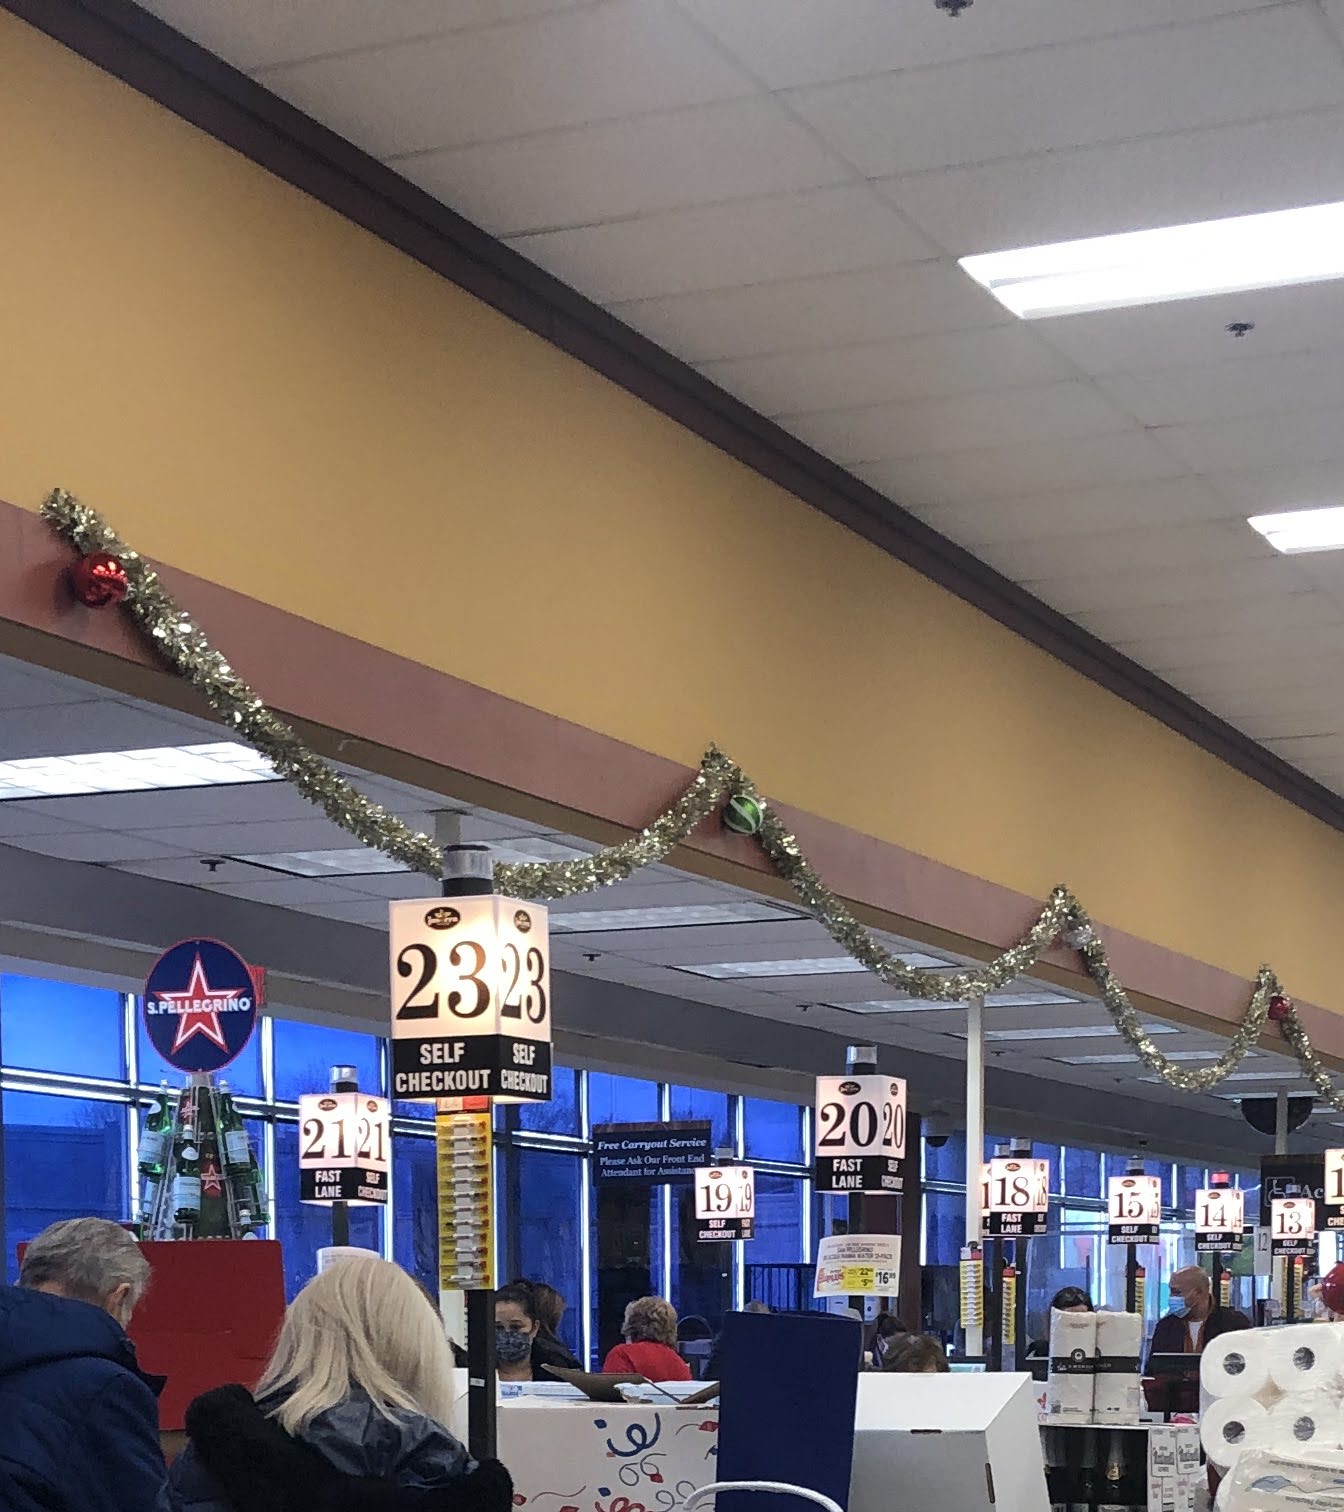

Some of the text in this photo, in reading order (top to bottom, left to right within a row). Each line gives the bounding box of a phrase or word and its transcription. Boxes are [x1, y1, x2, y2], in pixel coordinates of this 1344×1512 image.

[396, 941, 490, 1019] 23
[501, 943, 546, 1024] 23
[146, 995, 251, 1015] S.PELLEGRINO
[420, 1042, 465, 1064] SELF
[513, 1043, 536, 1065] SELF
[396, 1069, 491, 1092] CHECKOUT
[501, 1069, 548, 1094] CHECKOUT
[818, 1101, 878, 1147] 20
[883, 1102, 904, 1149] 20
[301, 1118, 352, 1160] 21
[357, 1117, 387, 1162] 21
[597, 1137, 708, 1151] Free Carryout Service
[599, 1157, 626, 1166] Please
[627, 1156, 642, 1165] Ask
[662, 1155, 686, 1164] Front
[687, 1153, 706, 1163] End
[832, 1158, 864, 1172] FAST
[314, 1170, 342, 1183] FAST
[601, 1167, 642, 1177] Attendant
[831, 1174, 864, 1189] LANE
[314, 1185, 342, 1198] LANE
[700, 1184, 733, 1213] 19
[995, 1176, 1031, 1207] 18
[1113, 1192, 1144, 1219] 15
[1200, 1204, 1228, 1228] 14
[709, 1219, 726, 1229] SELF
[1000, 1224, 1023, 1234] LANE
[1001, 1213, 1023, 1223] FAST
[1275, 1211, 1303, 1235] 13
[698, 1229, 736, 1240] CHECKOUT
[1120, 1225, 1139, 1234] SELF
